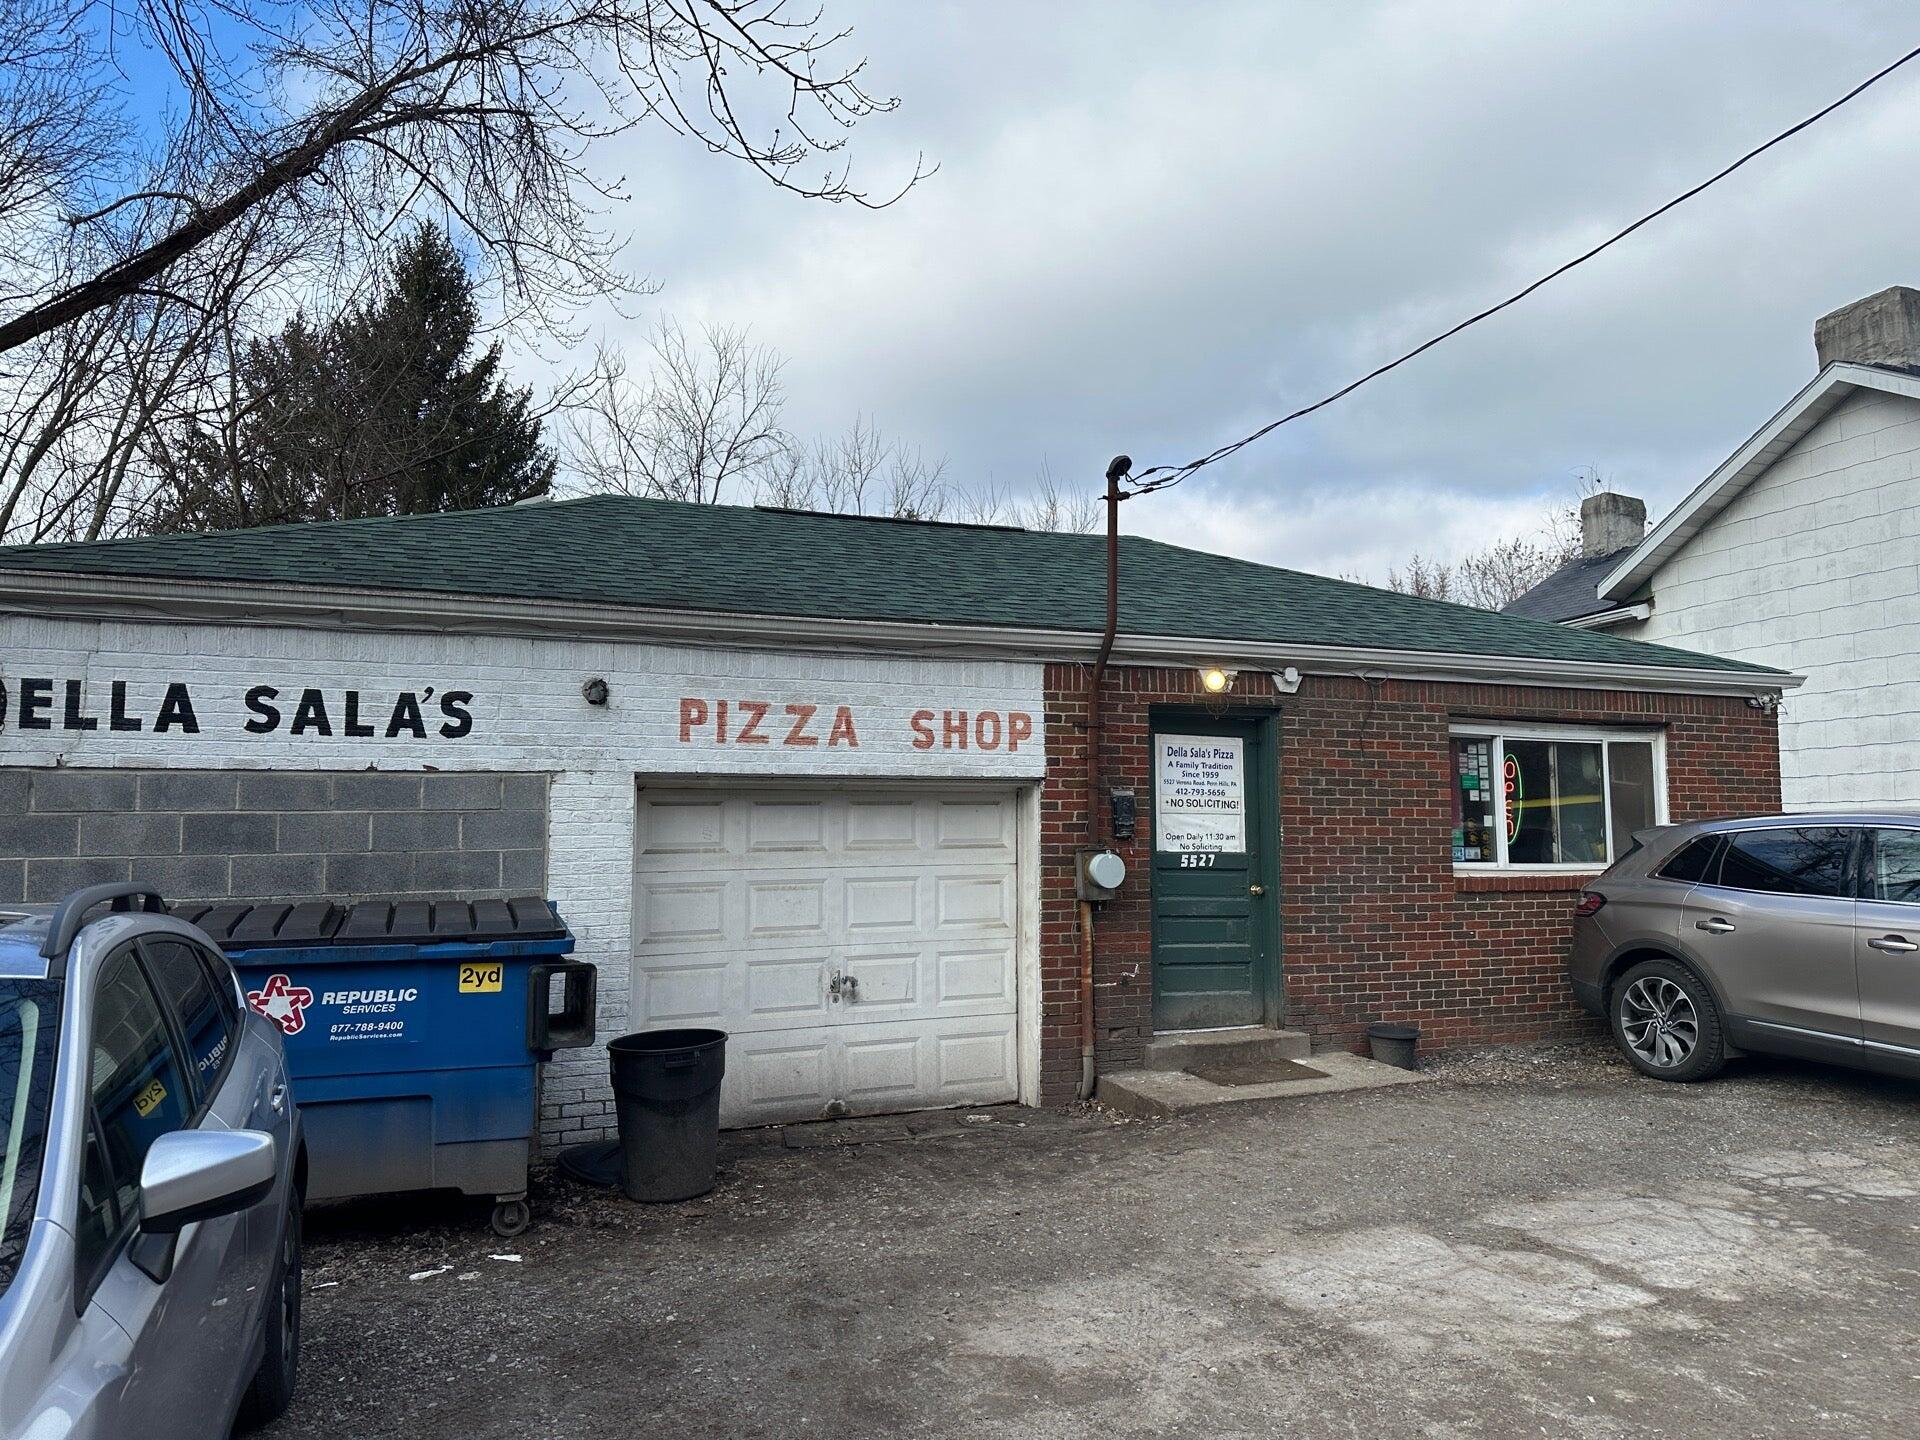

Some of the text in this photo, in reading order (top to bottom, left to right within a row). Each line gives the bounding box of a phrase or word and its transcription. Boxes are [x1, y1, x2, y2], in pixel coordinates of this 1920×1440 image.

[0, 677, 474, 738] ELLA SALA'S
[679, 698, 1032, 752] PIZZA SHOP
[1167, 746, 1234, 759] Della Sala's Pizza
[1176, 761, 1199, 770] Family
[1201, 762, 1233, 770] Tradition
[1182, 770, 1200, 778] Since
[1175, 788, 1226, 797] 412-793-5656
[1170, 799, 1239, 809] NO SOLICITING!
[1165, 832, 1184, 842] Open
[1187, 833, 1203, 842] Daily
[1205, 833, 1224, 841] 11:30
[1192, 843, 1222, 852] Soliciting
[1180, 854, 1215, 868] 5527
[462, 967, 500, 985] 2yd
[321, 988, 418, 1005] REPUBLIC
[342, 1003, 396, 1014] SERVICES
[330, 1021, 404, 1033] 877-788-9400
[329, 1032, 403, 1041] RepublicServices.com
